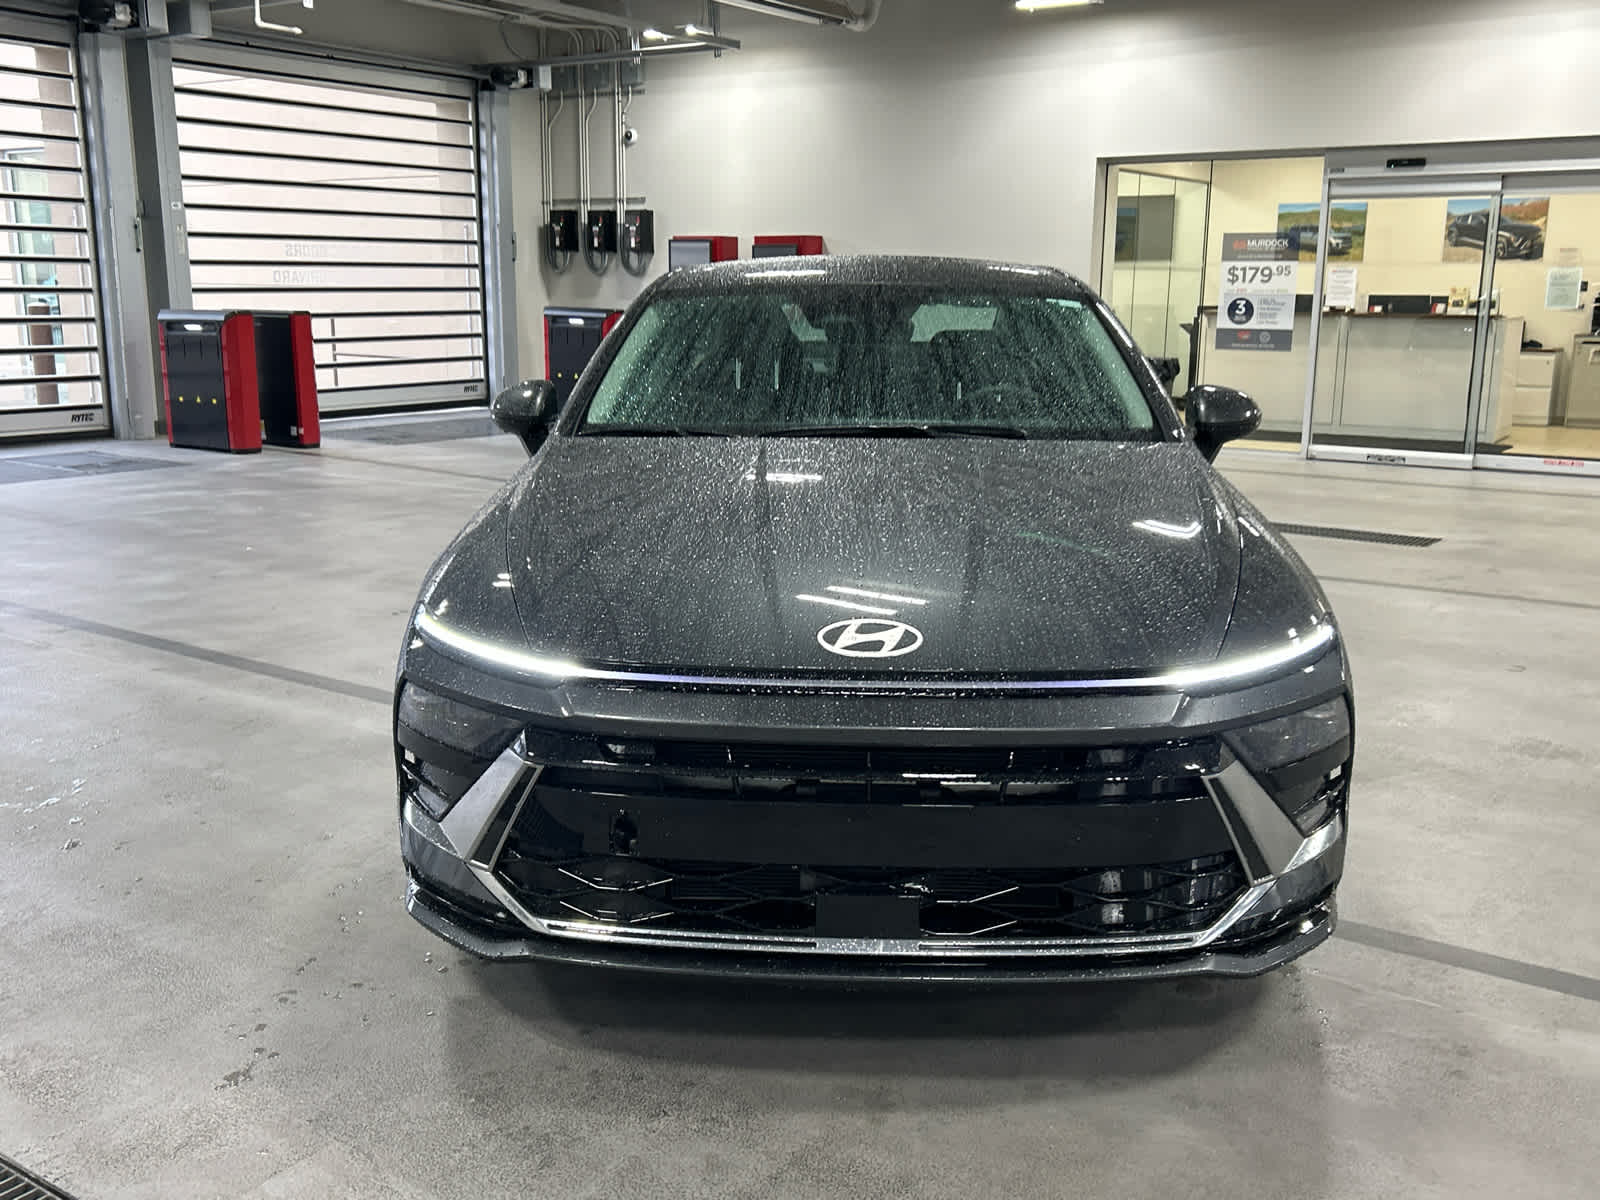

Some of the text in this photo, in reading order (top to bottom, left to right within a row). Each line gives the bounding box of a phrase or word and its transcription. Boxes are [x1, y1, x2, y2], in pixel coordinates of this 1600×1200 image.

[1247, 239, 1289, 249] MURDOCK
[1227, 265, 1291, 285] $179.95
[1235, 300, 1246, 314] 3
